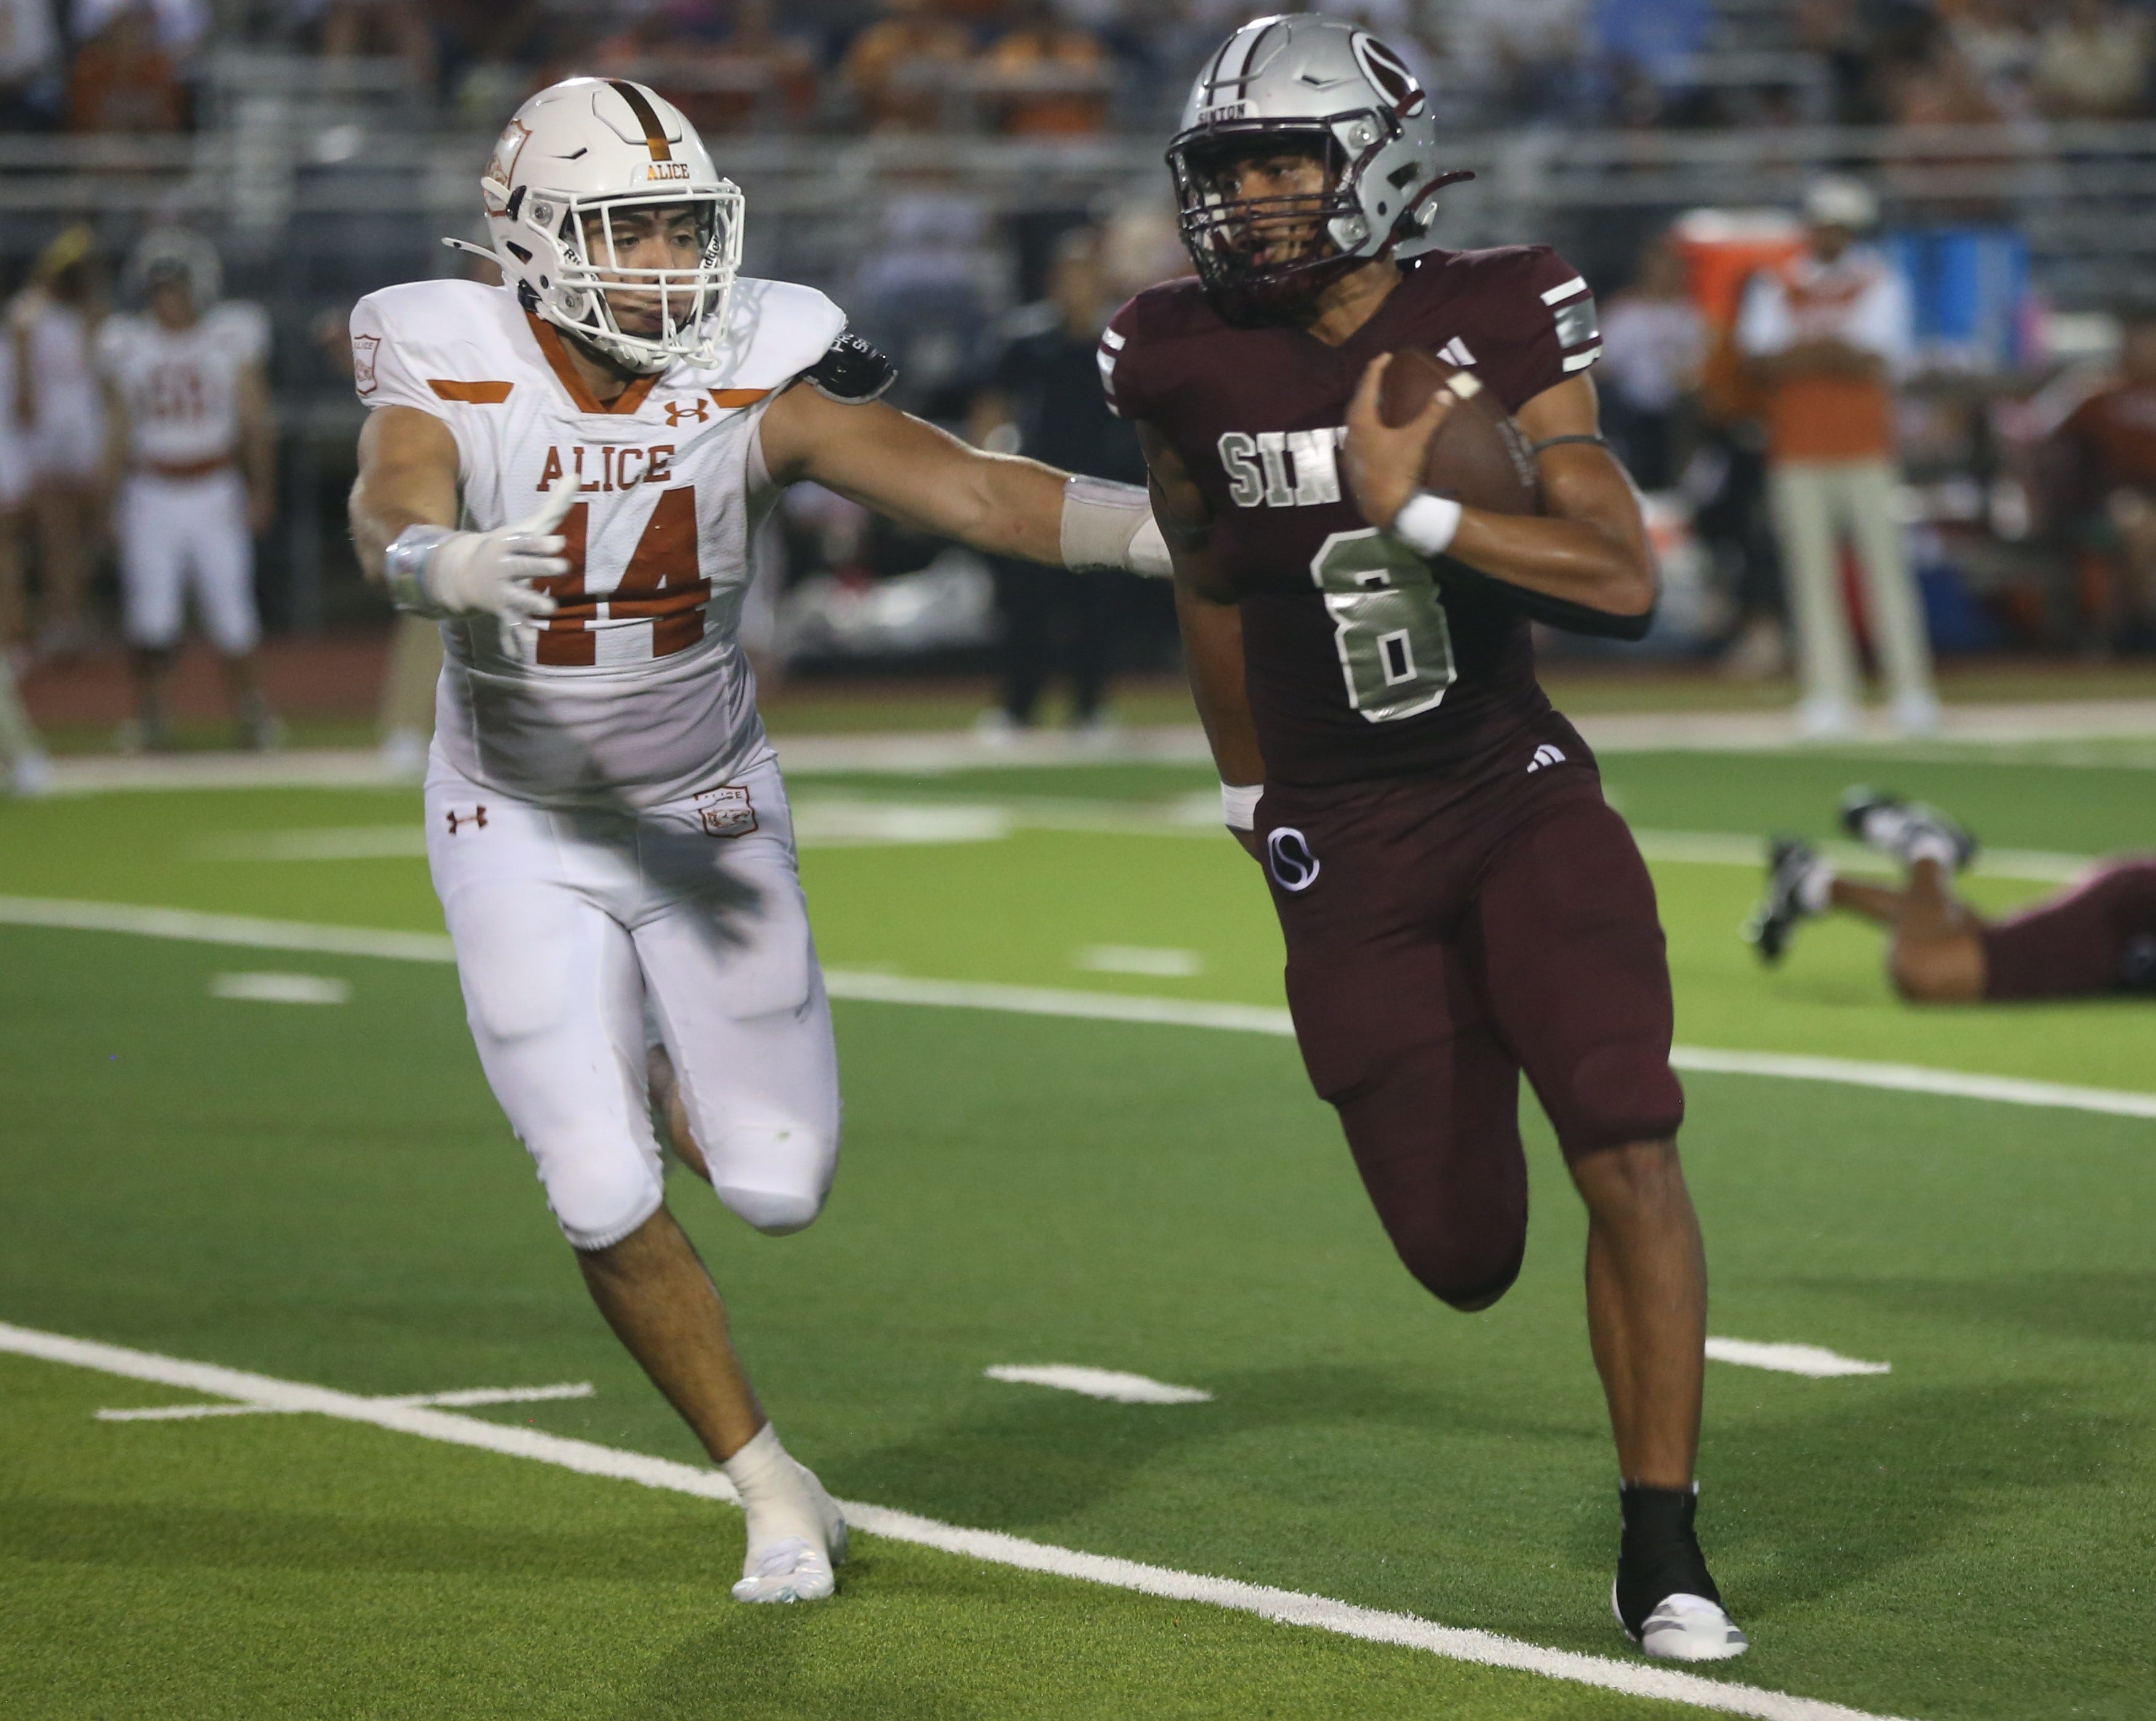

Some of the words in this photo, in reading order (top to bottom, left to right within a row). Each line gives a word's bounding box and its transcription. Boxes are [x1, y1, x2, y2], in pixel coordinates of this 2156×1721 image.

[647, 163, 690, 181] ALICE
[537, 444, 675, 492] ALICE
[1216, 425, 1350, 508] SIN
[531, 485, 712, 666] 44
[1310, 527, 1458, 724] 8
